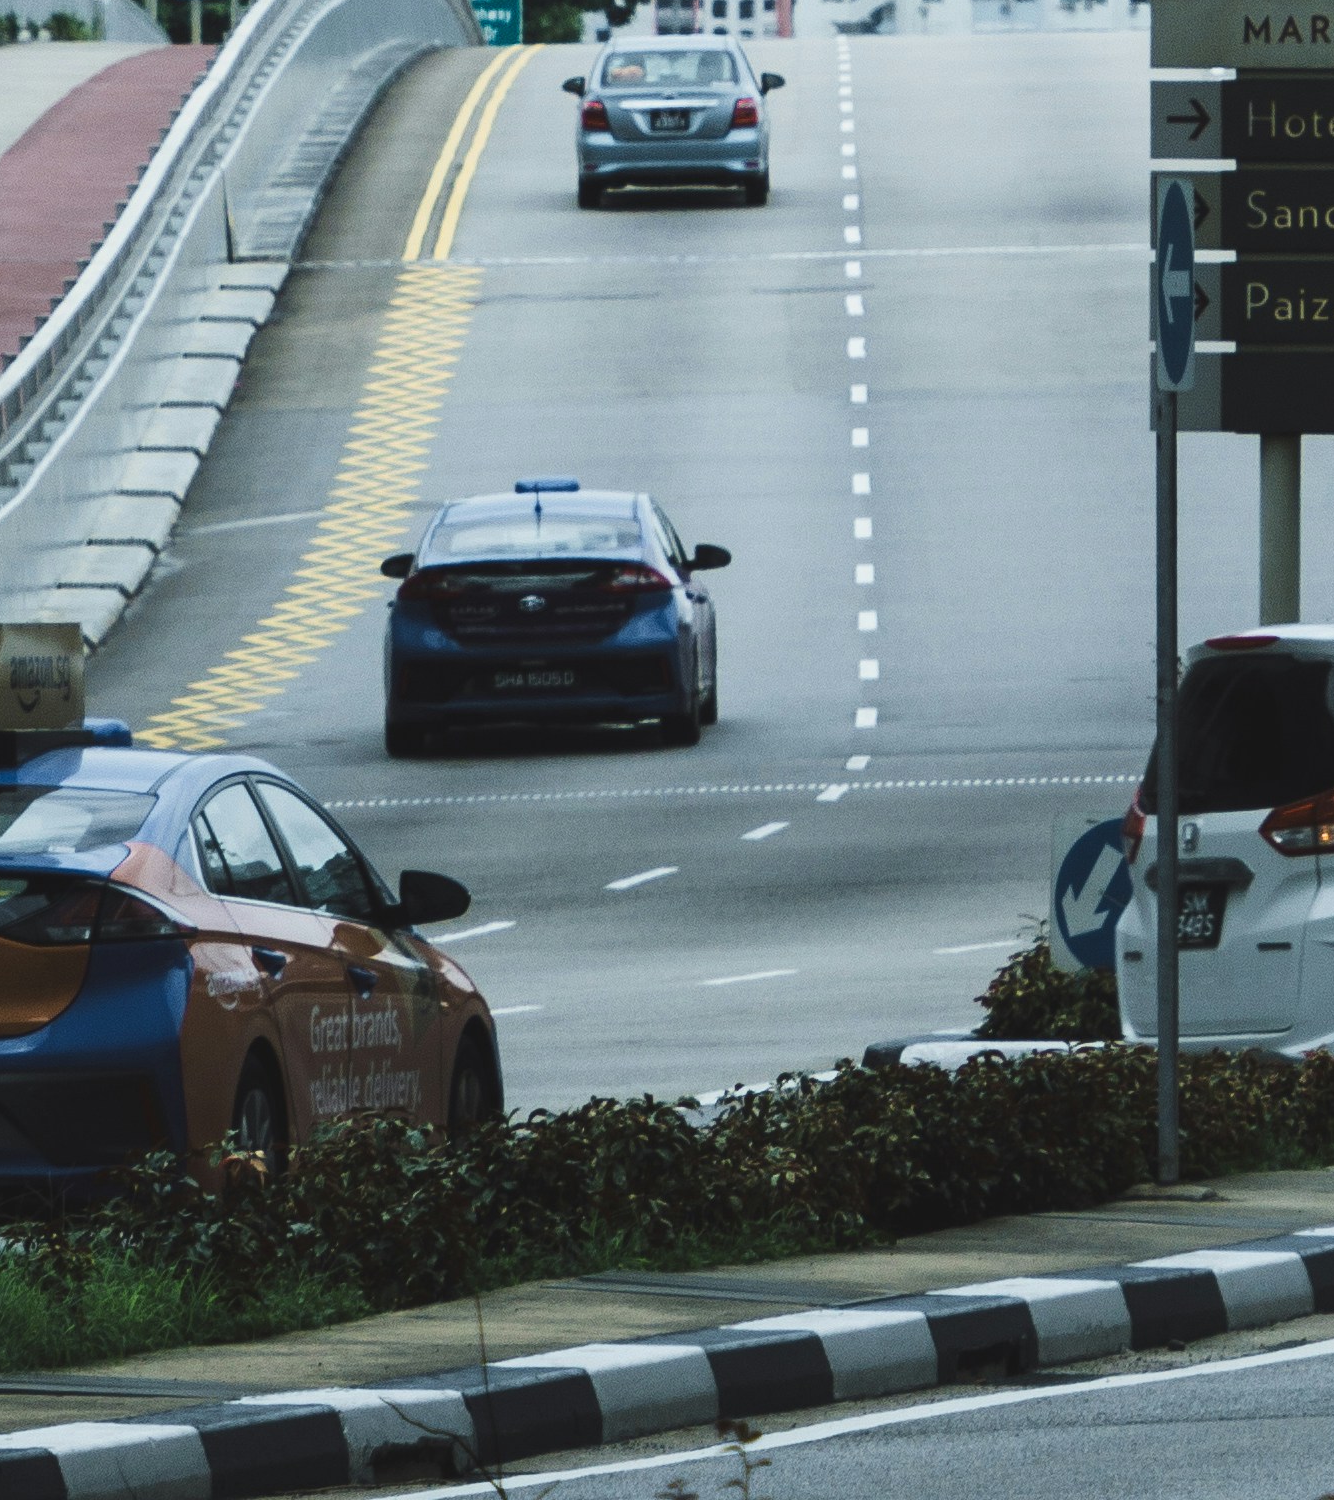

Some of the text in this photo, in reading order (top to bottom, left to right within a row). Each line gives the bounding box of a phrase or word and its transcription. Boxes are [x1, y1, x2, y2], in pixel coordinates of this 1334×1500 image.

[10, 656, 71, 702] amazon.sg
[310, 997, 403, 1055] Great brands,
[309, 1056, 422, 1116] reliable delivery.
